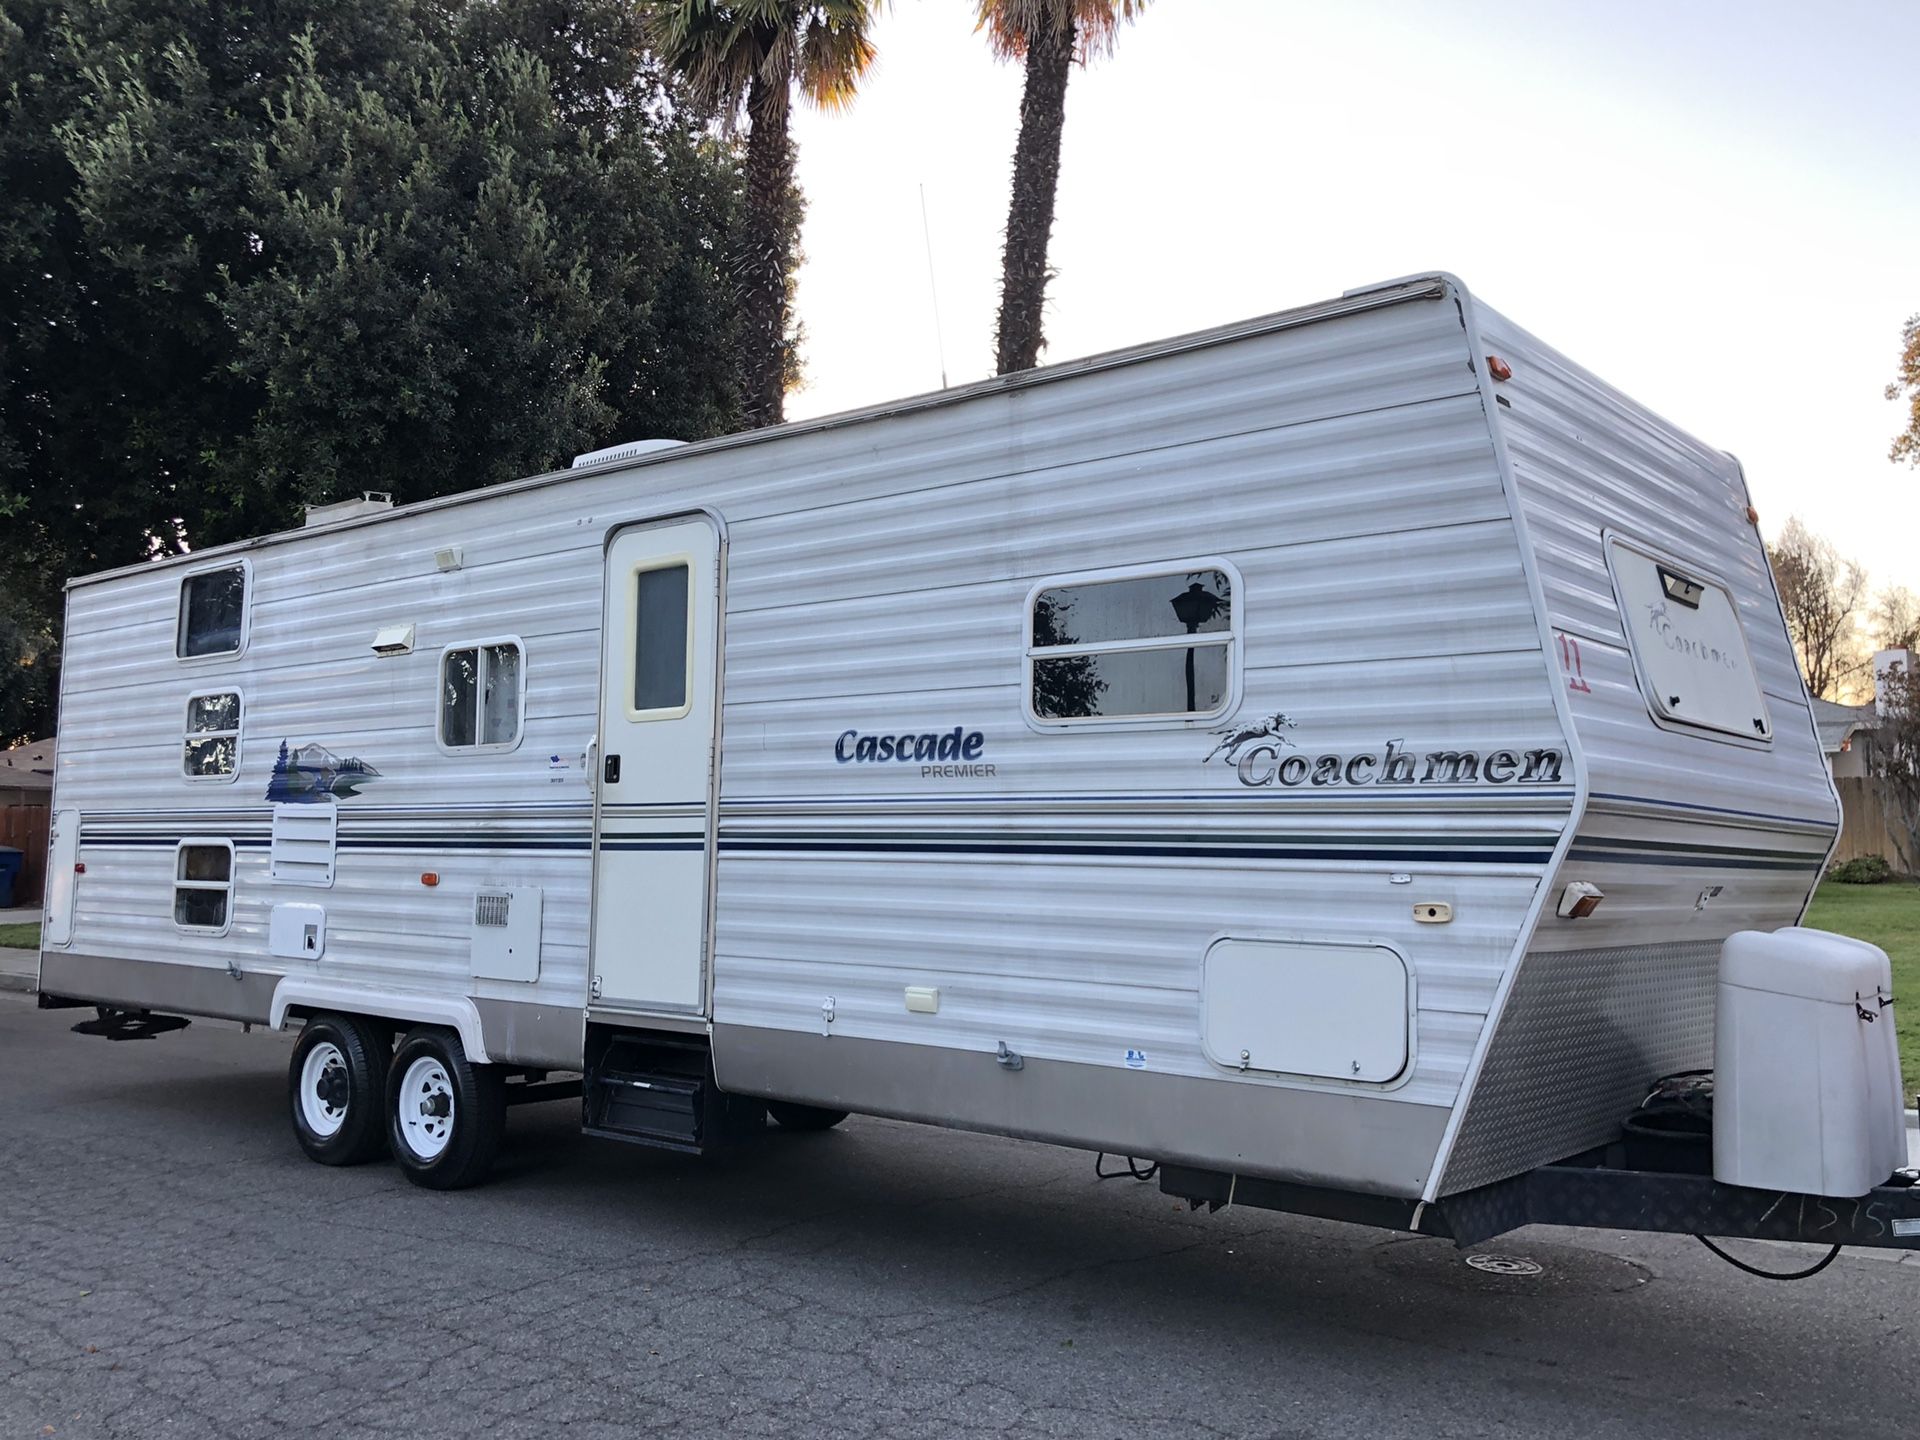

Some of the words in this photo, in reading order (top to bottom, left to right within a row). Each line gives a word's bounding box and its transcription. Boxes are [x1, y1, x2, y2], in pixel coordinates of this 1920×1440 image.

[835, 726, 985, 763] Cascade
[1237, 738, 1563, 787] Coachmen
[921, 764, 996, 778] PREMIER
